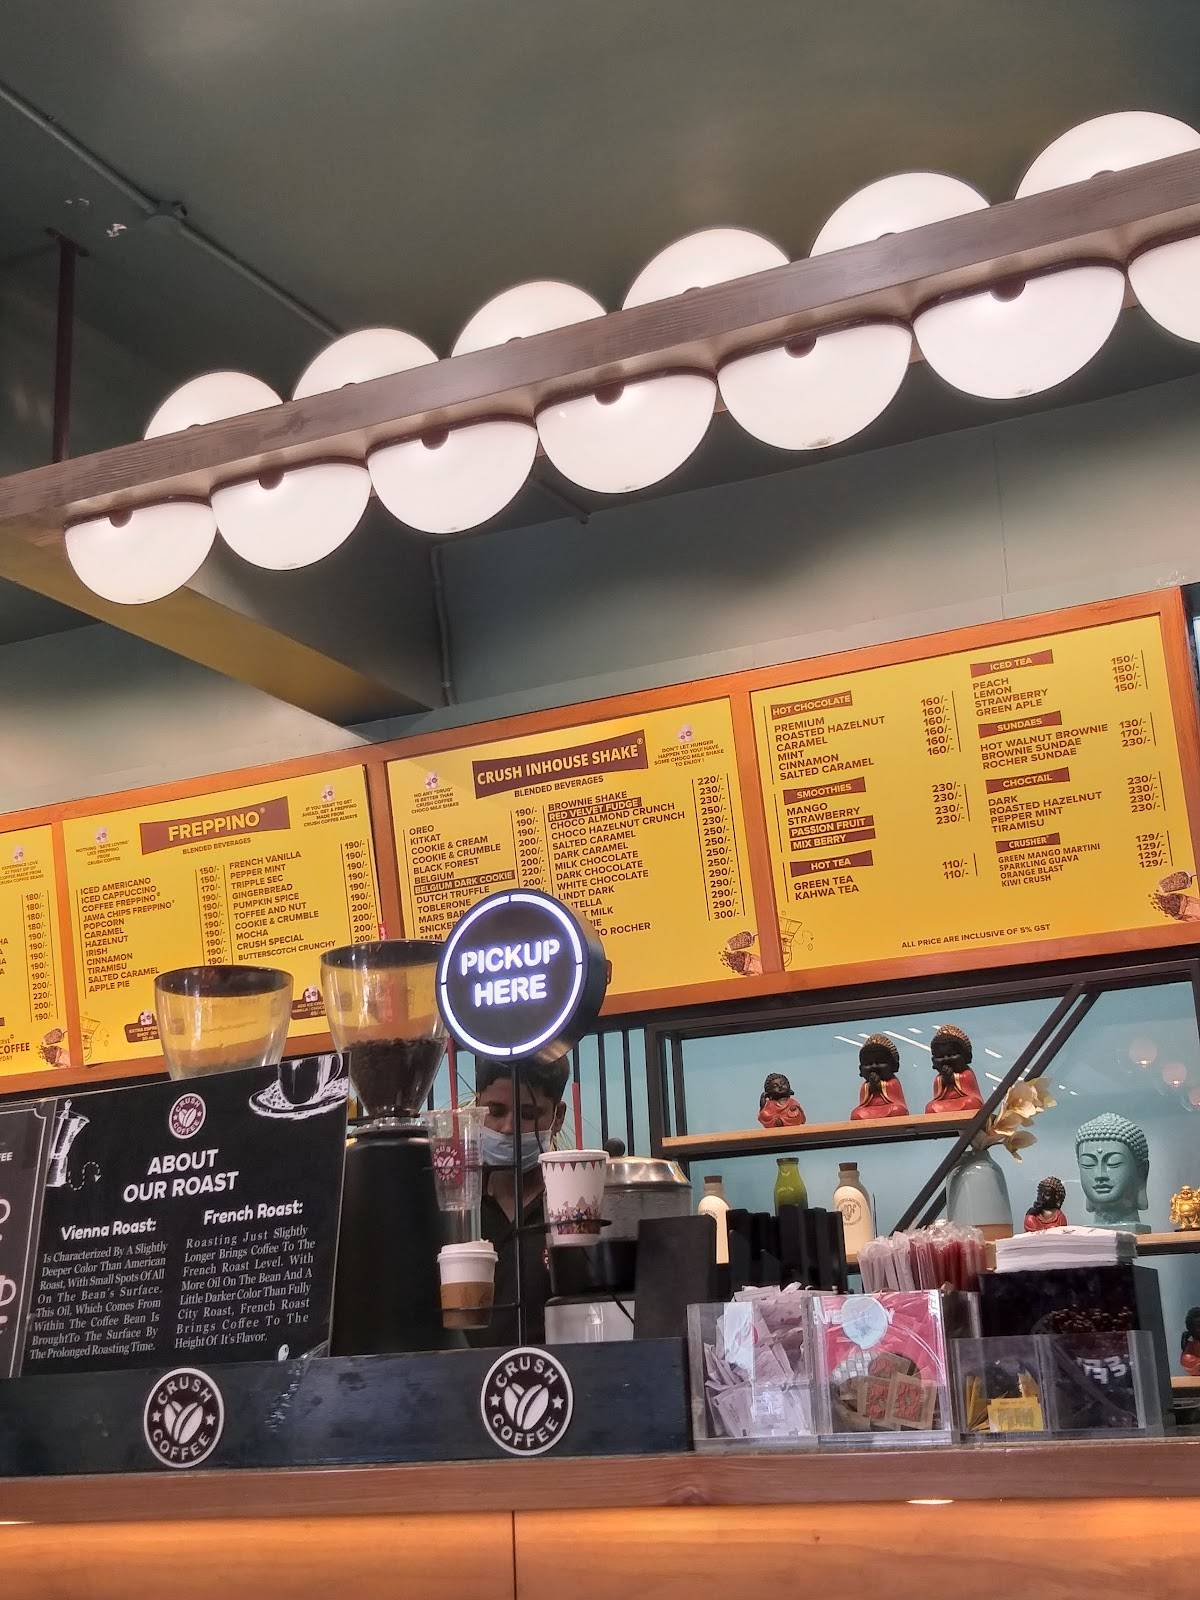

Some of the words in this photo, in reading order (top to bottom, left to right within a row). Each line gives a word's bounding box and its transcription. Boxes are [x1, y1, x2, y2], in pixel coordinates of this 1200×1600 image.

[990, 661, 1012, 670] ICED
[1014, 658, 1032, 666] TEA
[973, 678, 1008, 690] PEACH
[974, 686, 1012, 699] LEMON
[772, 706, 791, 716] HOT
[794, 695, 850, 711] CHOCOLATE
[975, 688, 1048, 708] STRAWBERRY
[976, 704, 1012, 716] GREEN
[1016, 698, 1042, 710] APLE
[775, 717, 824, 733] PREMIUM
[776, 727, 824, 742] ROASTED
[828, 716, 885, 733] HAZELNUT
[997, 718, 1042, 731] SUNDAES
[777, 736, 828, 752] CARAMEL
[980, 742, 1002, 752] HOT
[1006, 733, 1052, 747] WALNUT
[1056, 724, 1108, 739] BROWNIE
[778, 750, 804, 761] MINT
[982, 746, 1032, 760] BROWNIE
[1036, 738, 1082, 752] SUNDAE
[779, 754, 838, 770] CINNAMON
[983, 756, 1028, 770] ROCHER
[1031, 748, 1076, 761] SUNDAE
[478, 766, 522, 784] CRUSH
[526, 753, 588, 776] INHOUSE
[780, 767, 818, 780] SALTED
[822, 758, 874, 773] CARAMEL
[515, 785, 552, 797] BLENDED
[555, 776, 604, 790] BEVERAGES
[1003, 774, 1052, 787] CHOCTAIL
[797, 784, 851, 798] SMOOTHIES
[549, 797, 592, 811] BROWNIE
[596, 790, 627, 803] SHAKE
[787, 803, 828, 816] MANGO
[988, 795, 1018, 806] DARK
[990, 802, 1040, 815] ROASTED
[1044, 791, 1102, 807] HAZELNUT
[549, 811, 568, 821] RED
[570, 804, 604, 817] VELVET
[605, 799, 638, 811] FUDGE
[551, 818, 585, 830] CHOCO
[588, 811, 630, 824] ALMOND
[633, 802, 675, 816] CRUNCH
[788, 806, 860, 825] STRAWBERRY
[991, 812, 1032, 824] PEPPER
[1036, 807, 1063, 817] MINT
[410, 825, 434, 835] OREO
[552, 828, 586, 840] CHOCO
[589, 819, 640, 834] HAZELNUT
[643, 811, 685, 824] CRUNCH
[791, 823, 834, 836] PASSION
[837, 818, 866, 829] FRUIT
[992, 818, 1044, 832] TIRAMISU
[410, 834, 440, 845] KITKAT
[412, 842, 445, 855] COOKIE
[456, 836, 488, 847] CREAM
[553, 838, 587, 850] SALTED
[590, 830, 636, 844] CARAMEL
[794, 840, 812, 849] MIX
[814, 834, 846, 846] BERRY
[998, 854, 1025, 863] GREEN
[1028, 849, 1060, 859] MANGO
[1063, 843, 1100, 854] MARTINI
[231, 868, 262, 879] PEPPER
[265, 864, 286, 873] MINT
[414, 863, 442, 874] BLACK
[445, 857, 479, 869] FOREST
[556, 870, 582, 880] DARK
[585, 860, 643, 876] CHOCOLATE
[811, 861, 830, 870] HOT
[832, 858, 851, 867] TEA
[1000, 859, 1046, 871] SPARKLING
[1049, 855, 1079, 864] GUAVA
[1001, 869, 1035, 879] ORANGE
[1038, 865, 1063, 874] BLAST
[415, 872, 454, 884] BELGIUM
[415, 882, 452, 893] BELGIUM
[455, 877, 477, 887] DARK
[480, 871, 512, 883] COOKIE
[557, 879, 587, 890] WHITE
[590, 870, 648, 885] CHOCOLATE
[794, 878, 829, 890] GREEN
[832, 875, 854, 885] TEA
[1002, 879, 1021, 887] KIWI
[1024, 874, 1051, 884] CRUSH
[232, 884, 293, 899] GINGERBREAD
[417, 892, 448, 904] DUTCH
[450, 886, 490, 898] TRUFFLE
[559, 890, 586, 900] LINDT
[588, 885, 615, 896] DARK
[418, 899, 471, 914] TOBLERONE
[84, 918, 124, 930] POPCORN
[85, 928, 124, 939] CARAMEL
[85, 935, 128, 948] HAZELNUT
[918, 938, 941, 946] PRICE
[962, 930, 1005, 940] INCLUSIVE
[87, 953, 132, 965] CINNAMON
[461, 939, 560, 976] PICKUP
[88, 963, 127, 974] TIRAMISU
[474, 974, 547, 1008] HERE
[175, 1097, 200, 1112] CRUSH
[174, 1120, 199, 1135] COFFEE
[147, 1148, 219, 1175] ABOUT
[123, 1181, 167, 1203] OUR
[172, 1171, 239, 1197] ROAST
[204, 1204, 253, 1225] French
[258, 1200, 303, 1218] Roast:
[62, 1225, 109, 1240] Vienna
[113, 1218, 156, 1235] Roast:
[185, 1252, 216, 1263] Longer
[219, 1249, 247, 1260] Brings
[251, 1242, 279, 1255] Coffee
[282, 1241, 294, 1252] To
[298, 1238, 315, 1250] The
[42, 1267, 72, 1278] Deeper
[74, 1262, 98, 1273] Color
[100, 1260, 122, 1271] Than
[124, 1258, 166, 1269] American
[183, 1263, 216, 1277] French
[222, 1261, 249, 1272] Roast
[290, 1252, 313, 1265] With
[35, 1320, 64, 1331] Within
[69, 1318, 86, 1329] The
[91, 1315, 119, 1327] Coffee
[124, 1314, 146, 1324] Bean
[151, 1312, 160, 1322] Is
[496, 1356, 558, 1387] CRUSH
[158, 1376, 212, 1405] CRUSH
[493, 1413, 559, 1447] COFFEE
[153, 1429, 210, 1460] COFFEE
